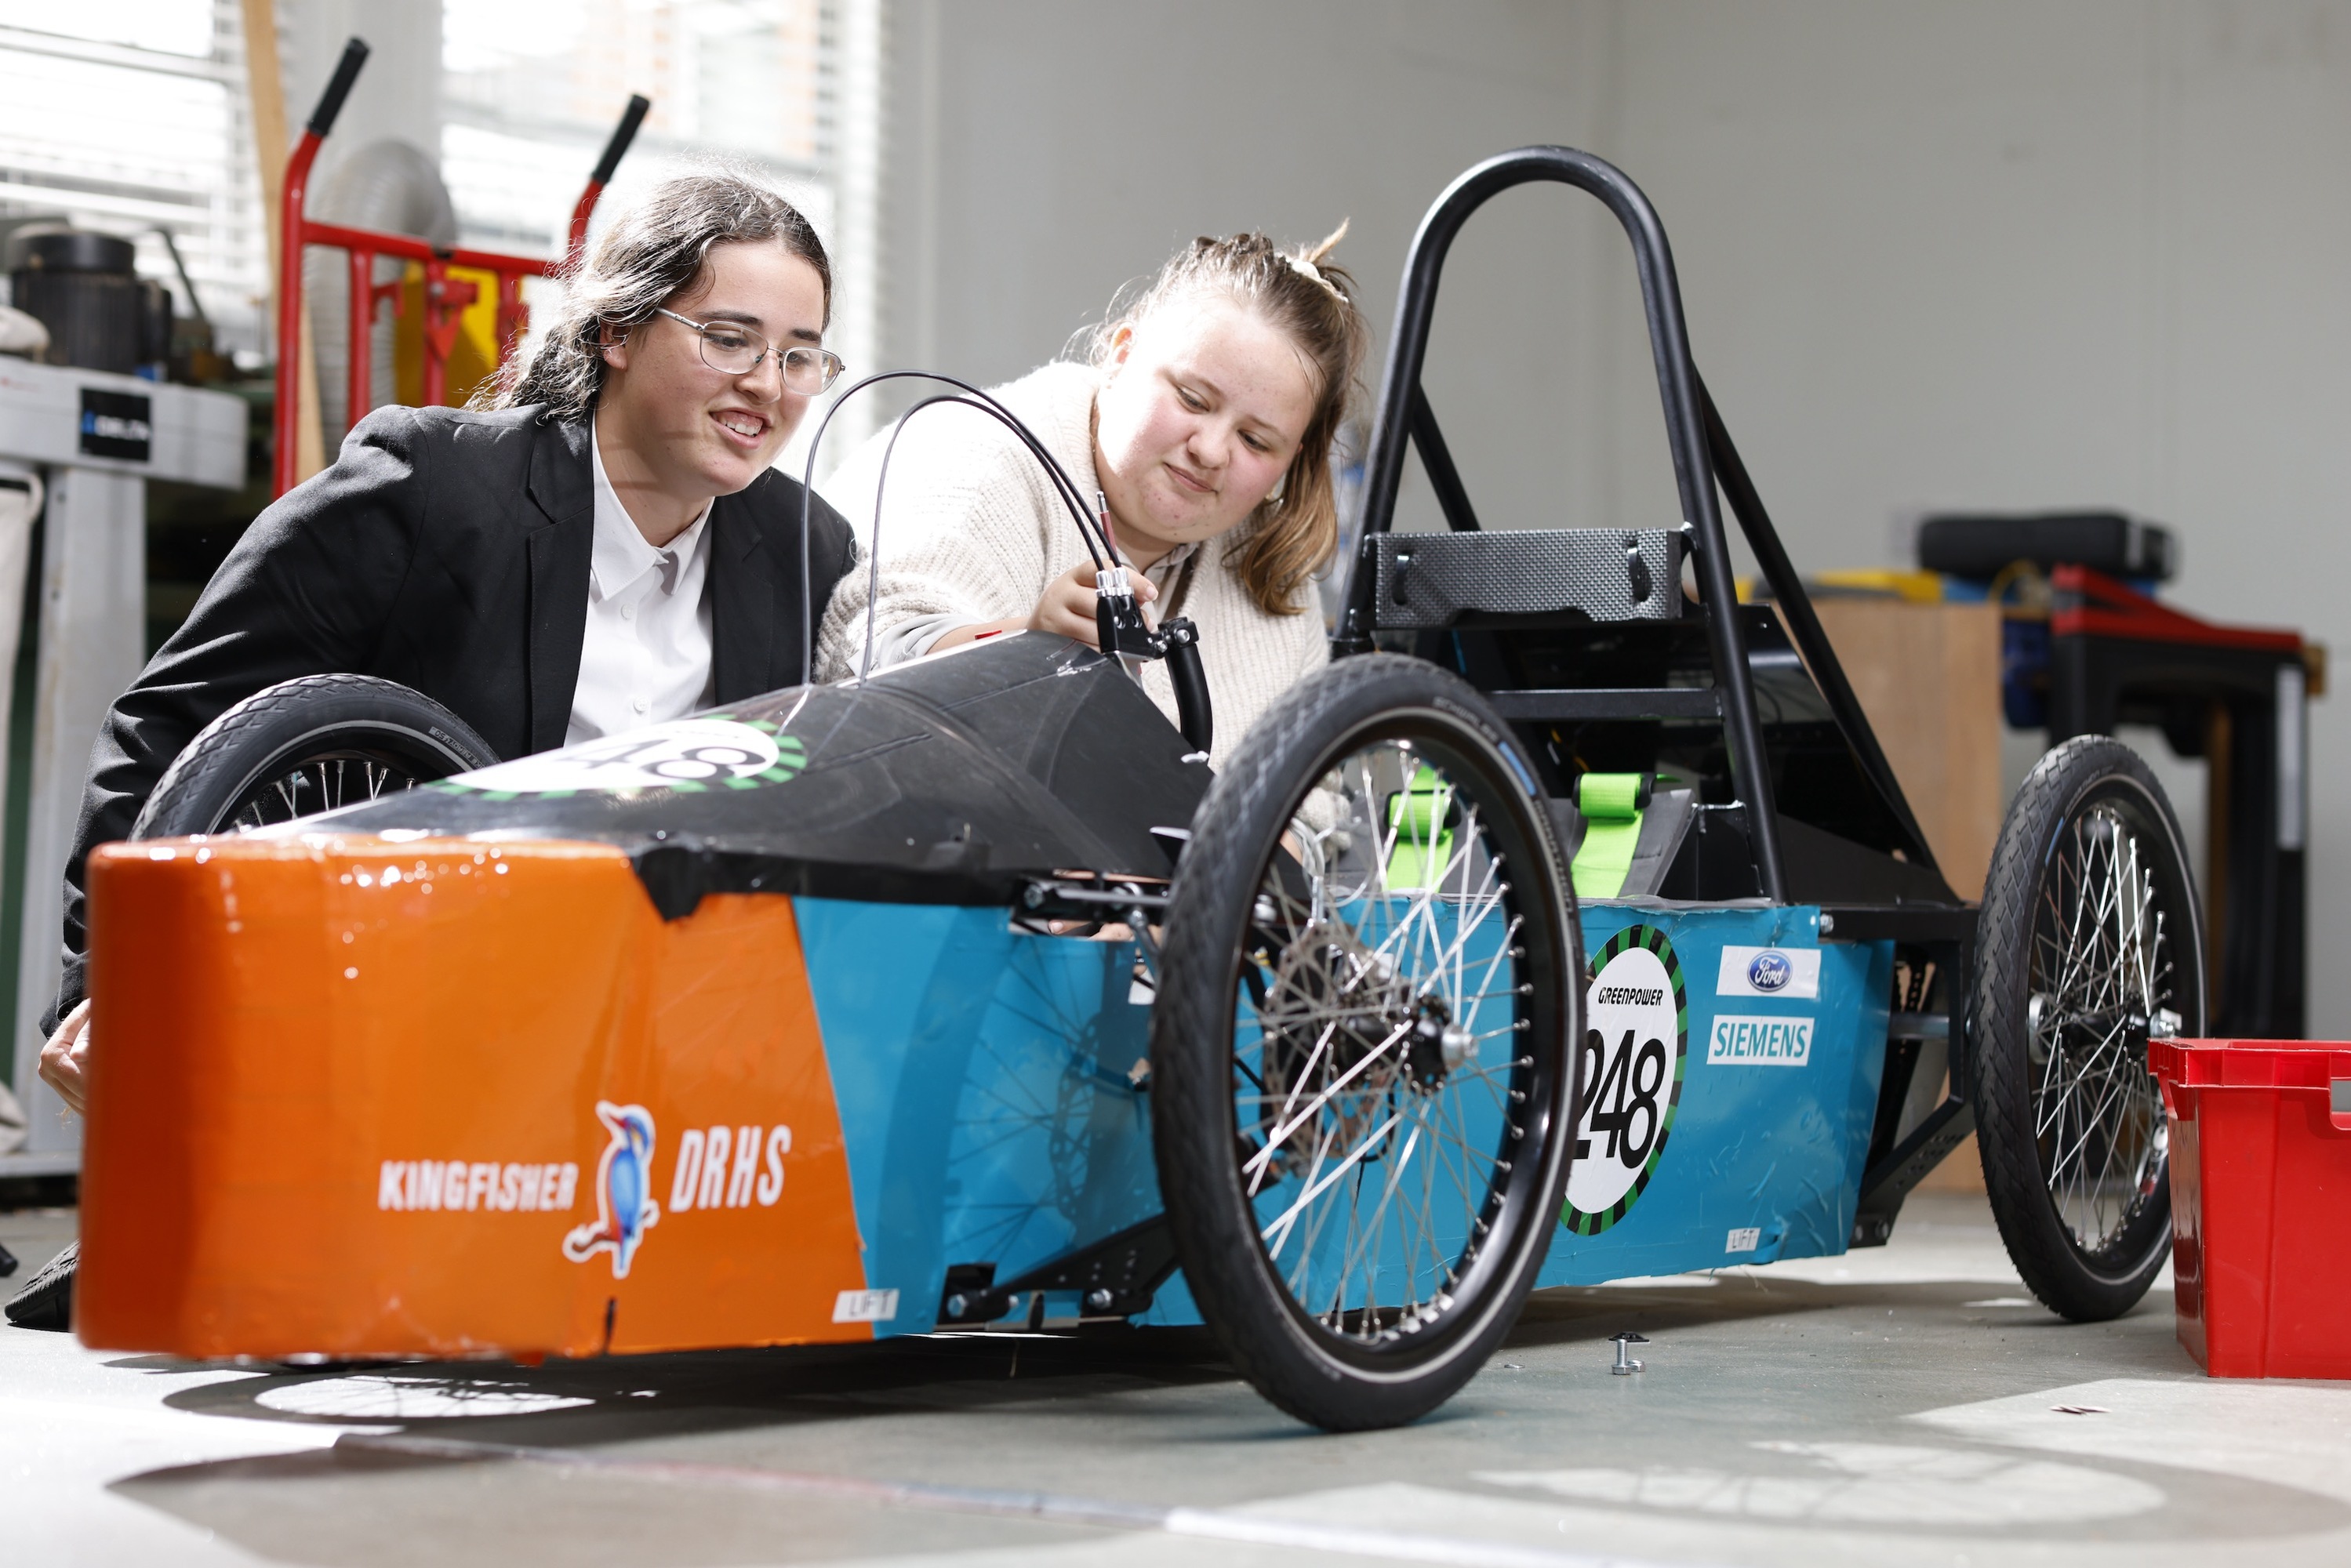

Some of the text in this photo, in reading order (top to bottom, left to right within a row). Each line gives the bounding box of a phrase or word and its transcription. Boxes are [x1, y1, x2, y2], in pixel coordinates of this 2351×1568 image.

[435, 731, 445, 739] 50
[1754, 956, 1786, 985] Ford
[1598, 987, 1663, 1006] GREENPOWER
[1713, 1022, 1808, 1058] SIEMENS
[1572, 1029, 1666, 1169] 248
[669, 1124, 791, 1212] DRHS
[378, 1160, 579, 1211] KINGFISHER
[1732, 1229, 1756, 1249] LIFT
[848, 1290, 892, 1316] LIFT
